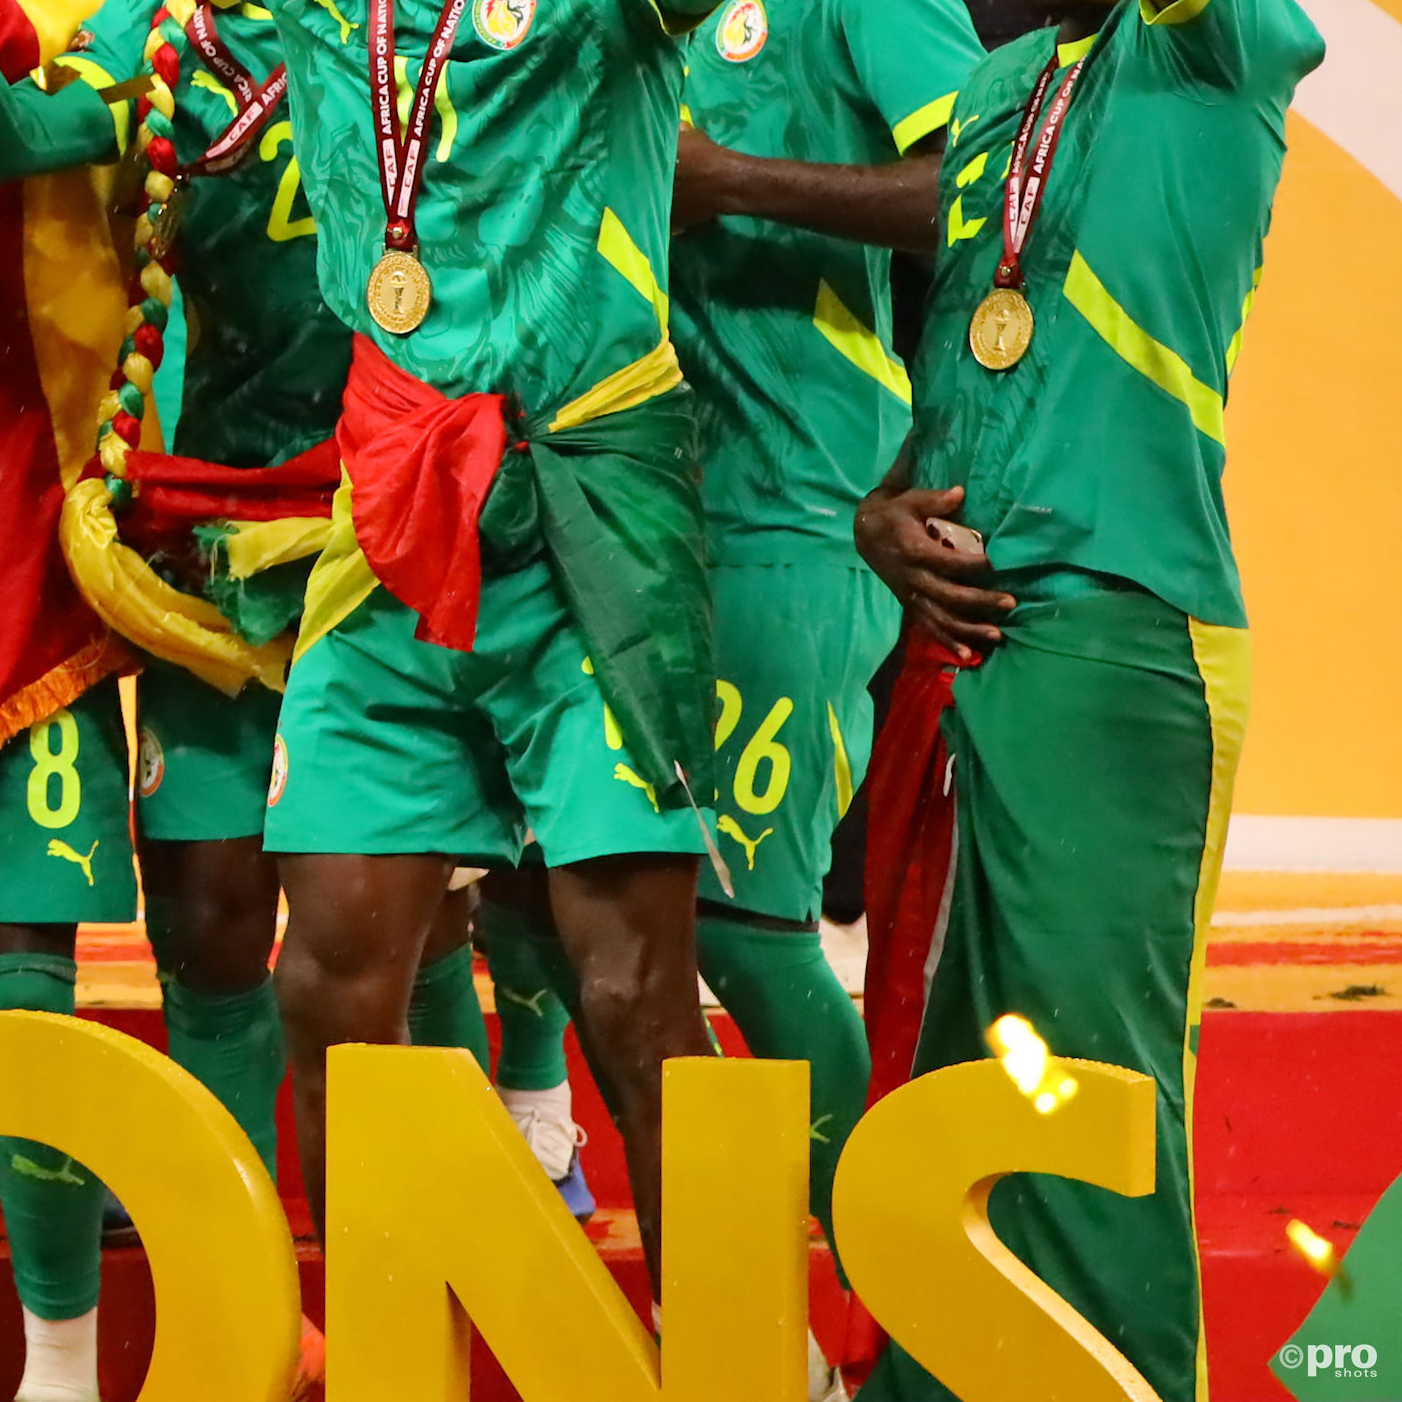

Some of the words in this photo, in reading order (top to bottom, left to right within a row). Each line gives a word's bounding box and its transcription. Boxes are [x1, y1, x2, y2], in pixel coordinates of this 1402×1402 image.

[200, 40, 216, 57] OF
[376, 34, 387, 56] OF
[213, 57, 235, 76] CUP
[377, 56, 388, 85] CUP
[414, 87, 430, 138] AFRICA
[425, 58, 437, 86] CUP
[433, 38, 446, 58] OF
[230, 110, 254, 141] CAF
[379, 85, 393, 135] AFRICA
[1034, 125, 1056, 174] AFRICA
[1050, 99, 1064, 125] CUP
[1061, 81, 1073, 98] OF
[403, 149, 417, 188] CAF
[1020, 186, 1034, 225] CAF
[26, 708, 82, 830] 8
